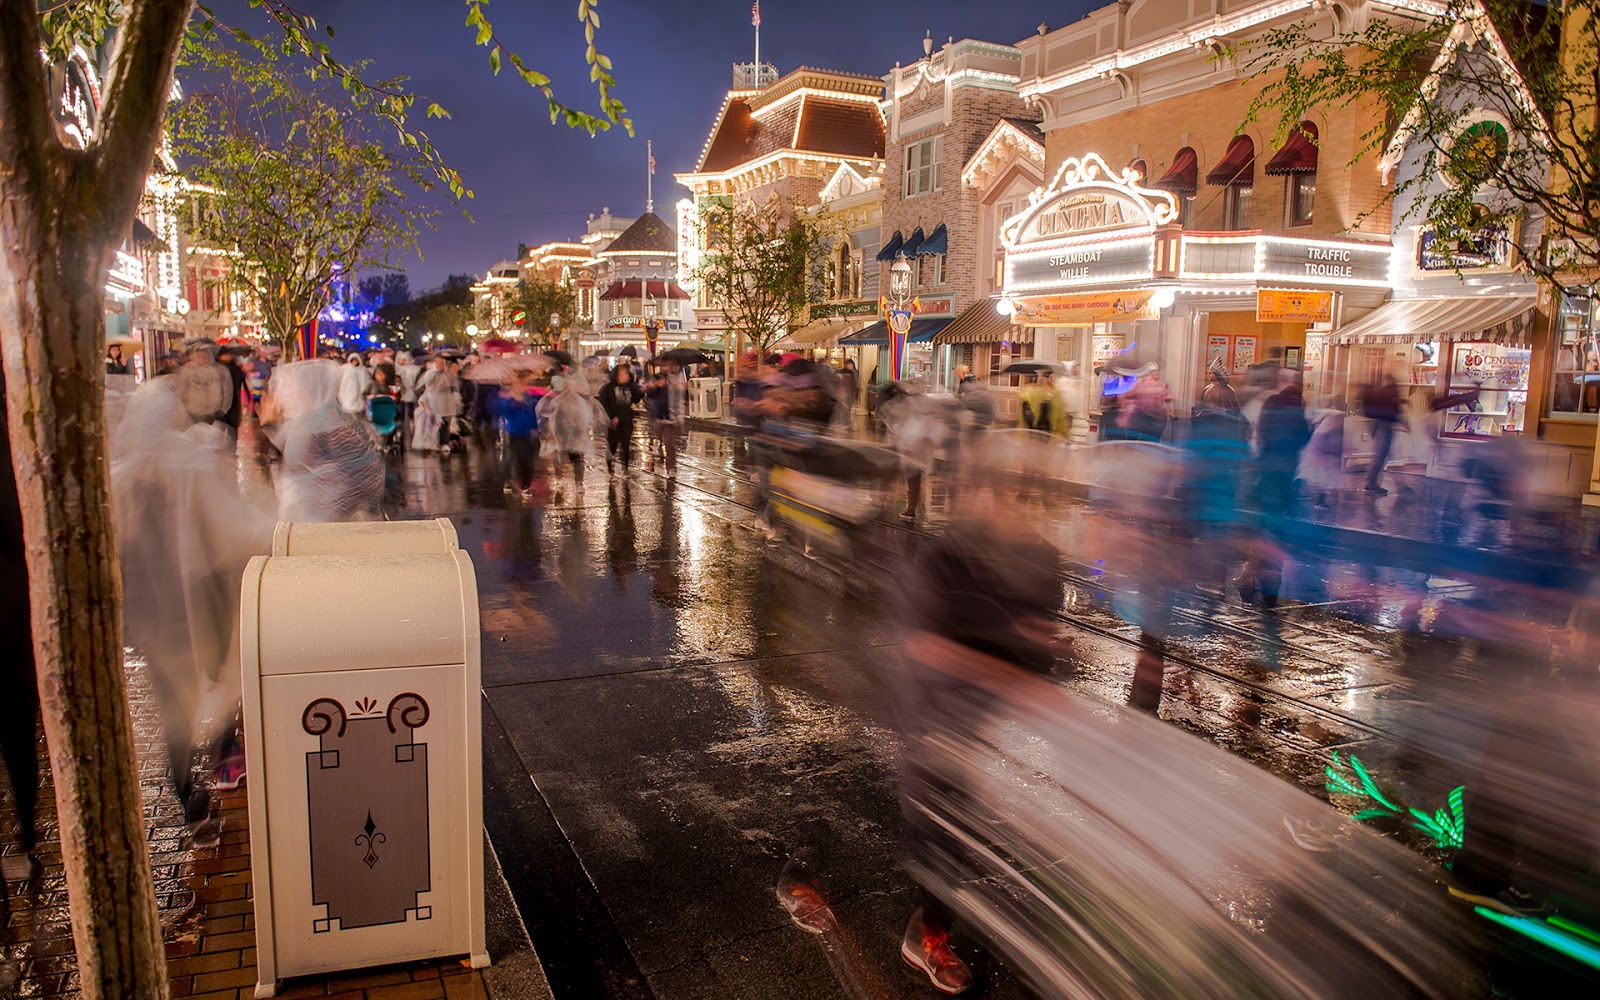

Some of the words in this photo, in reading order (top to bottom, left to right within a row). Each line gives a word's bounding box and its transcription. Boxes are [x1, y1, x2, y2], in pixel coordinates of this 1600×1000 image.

[1080, 193, 1104, 204] Street
[1036, 201, 1126, 237] CINEMA
[1049, 250, 1102, 267] STEAMBOAT
[1308, 247, 1351, 262] TRAFFIC
[1060, 267, 1089, 280] WILLIE
[1305, 263, 1352, 277] TROUBLE
